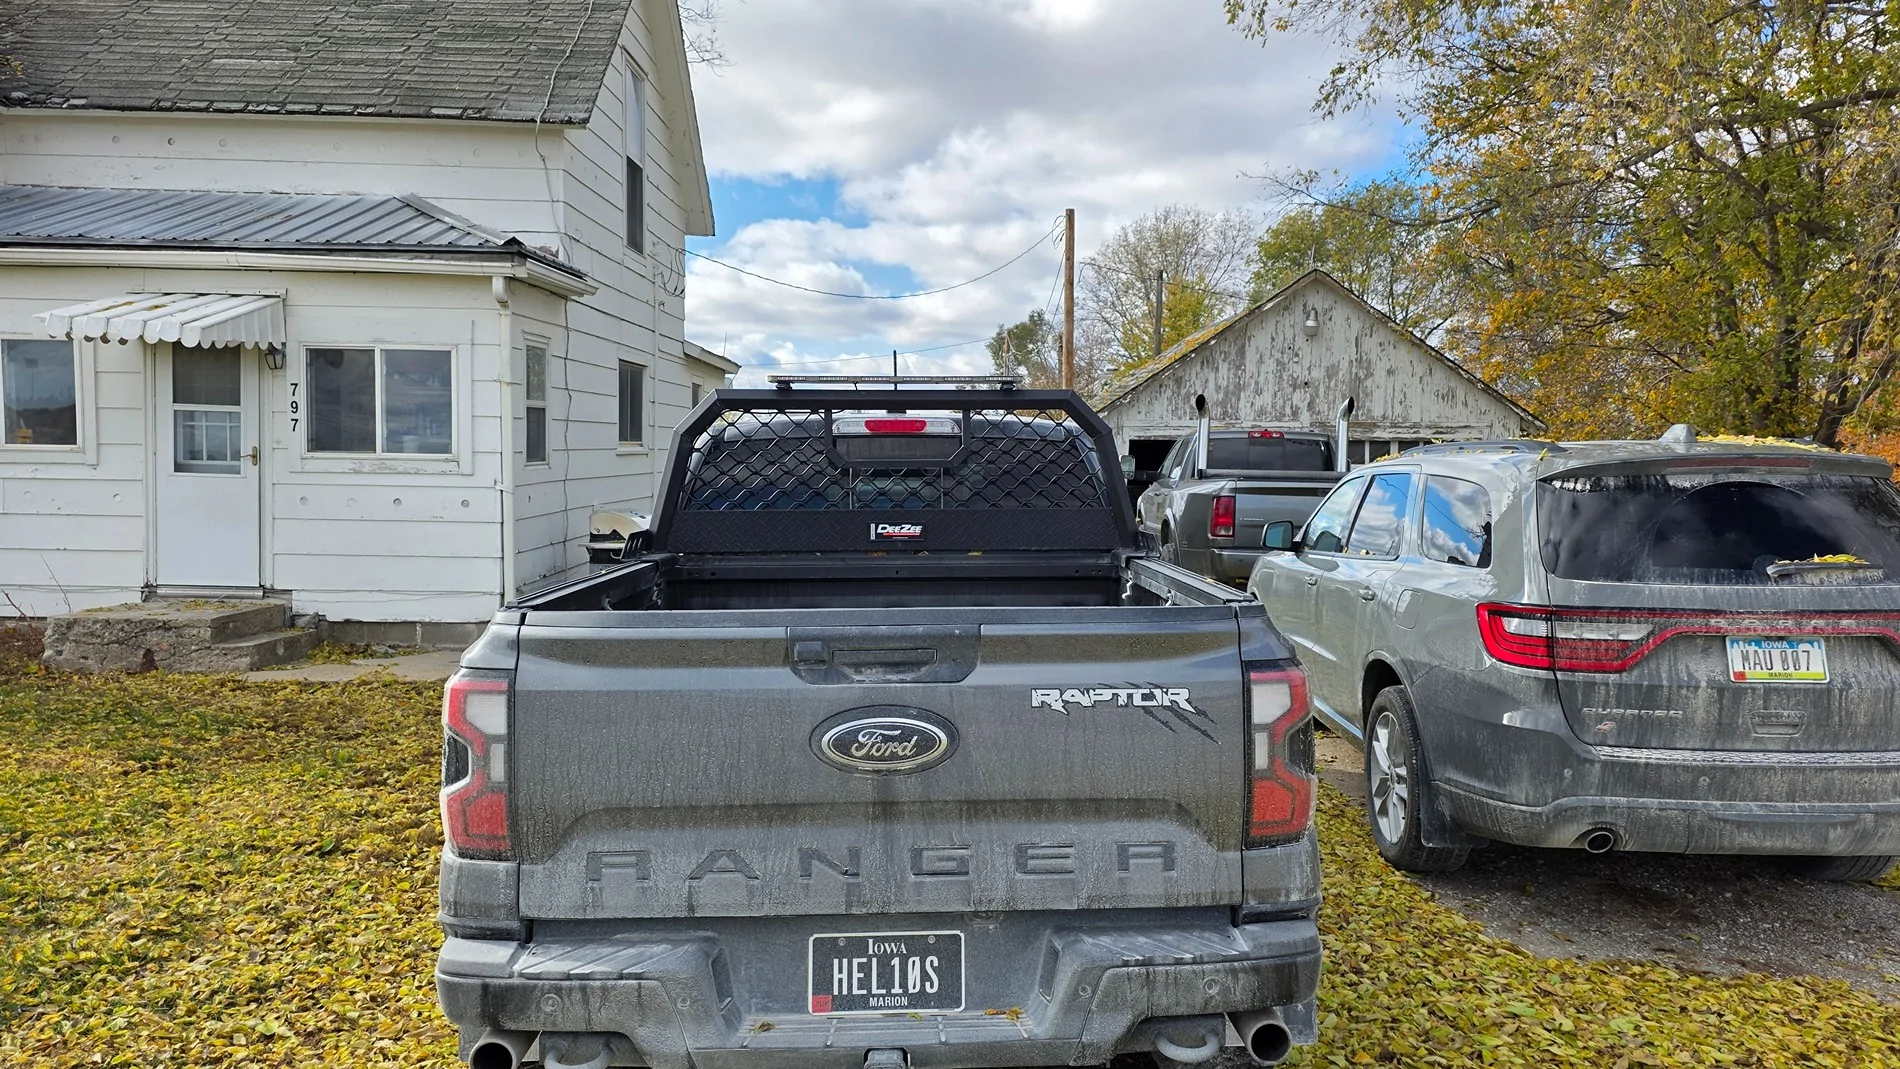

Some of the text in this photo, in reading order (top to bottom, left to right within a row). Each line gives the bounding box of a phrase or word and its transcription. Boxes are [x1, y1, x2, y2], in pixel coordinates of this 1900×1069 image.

[290, 383, 299, 432] 797
[1761, 640, 1790, 649] IOWA
[1741, 650, 1811, 671] MAU 007
[1030, 687, 1198, 715] RAPTOR
[851, 729, 918, 757] Ford
[586, 842, 1176, 882] RANGER
[833, 955, 939, 996] HEL10S
[869, 996, 908, 1007] MARION
